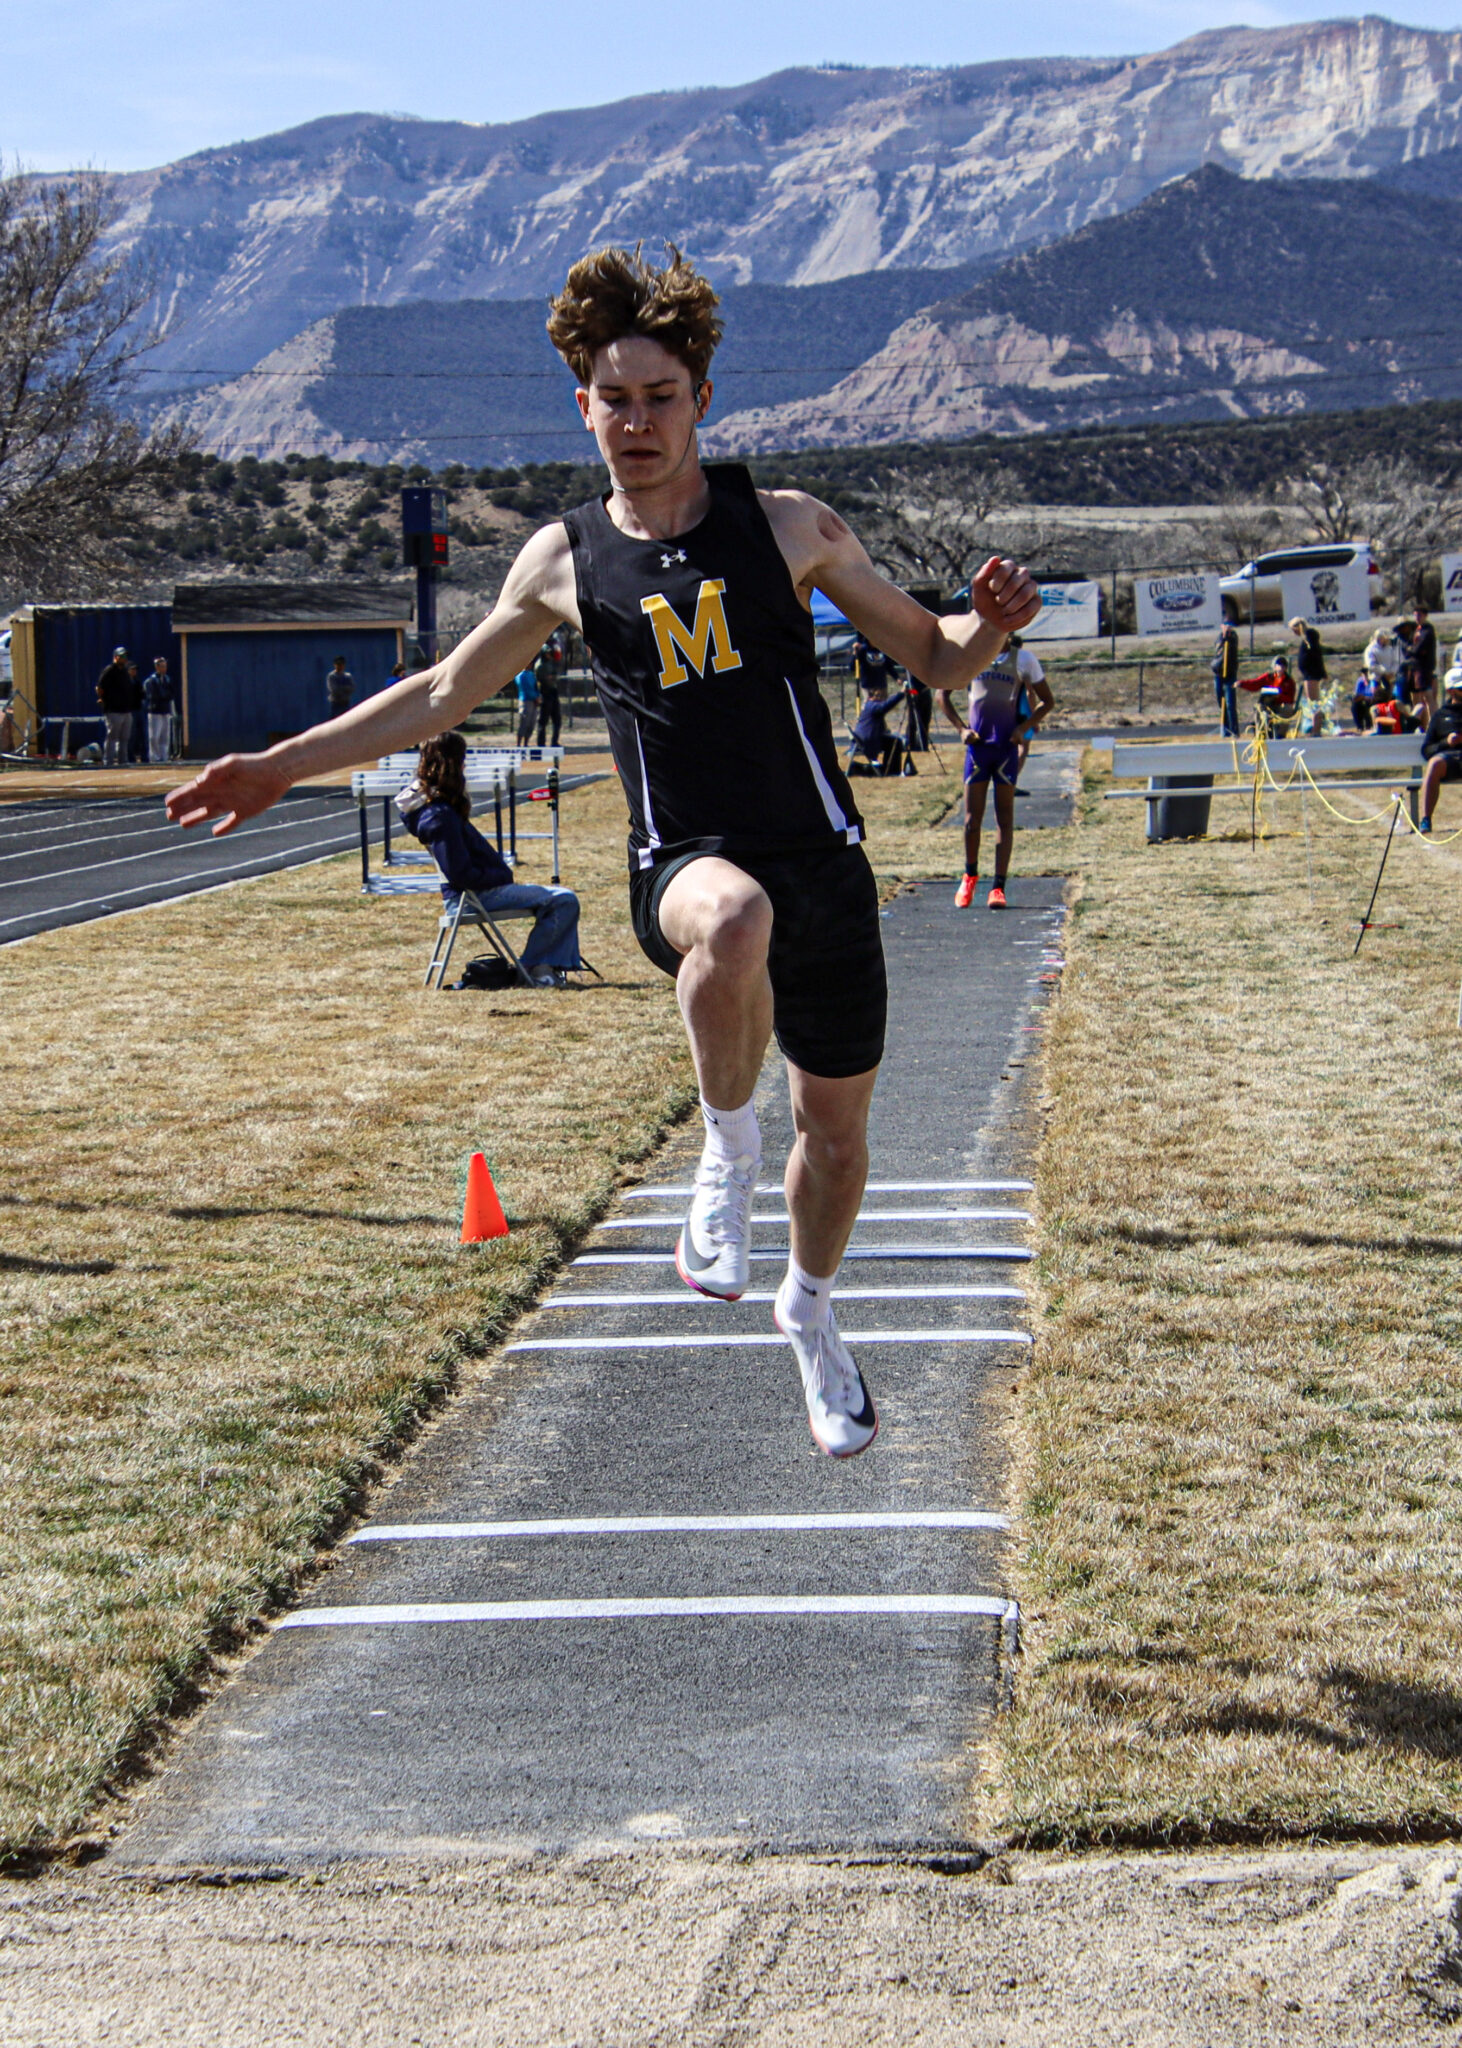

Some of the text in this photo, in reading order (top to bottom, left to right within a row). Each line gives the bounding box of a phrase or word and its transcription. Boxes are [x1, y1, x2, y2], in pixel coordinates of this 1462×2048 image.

[1149, 576, 1205, 599] COLUMBINE
[1163, 596, 1195, 608] Ford
[640, 578, 742, 690] M
